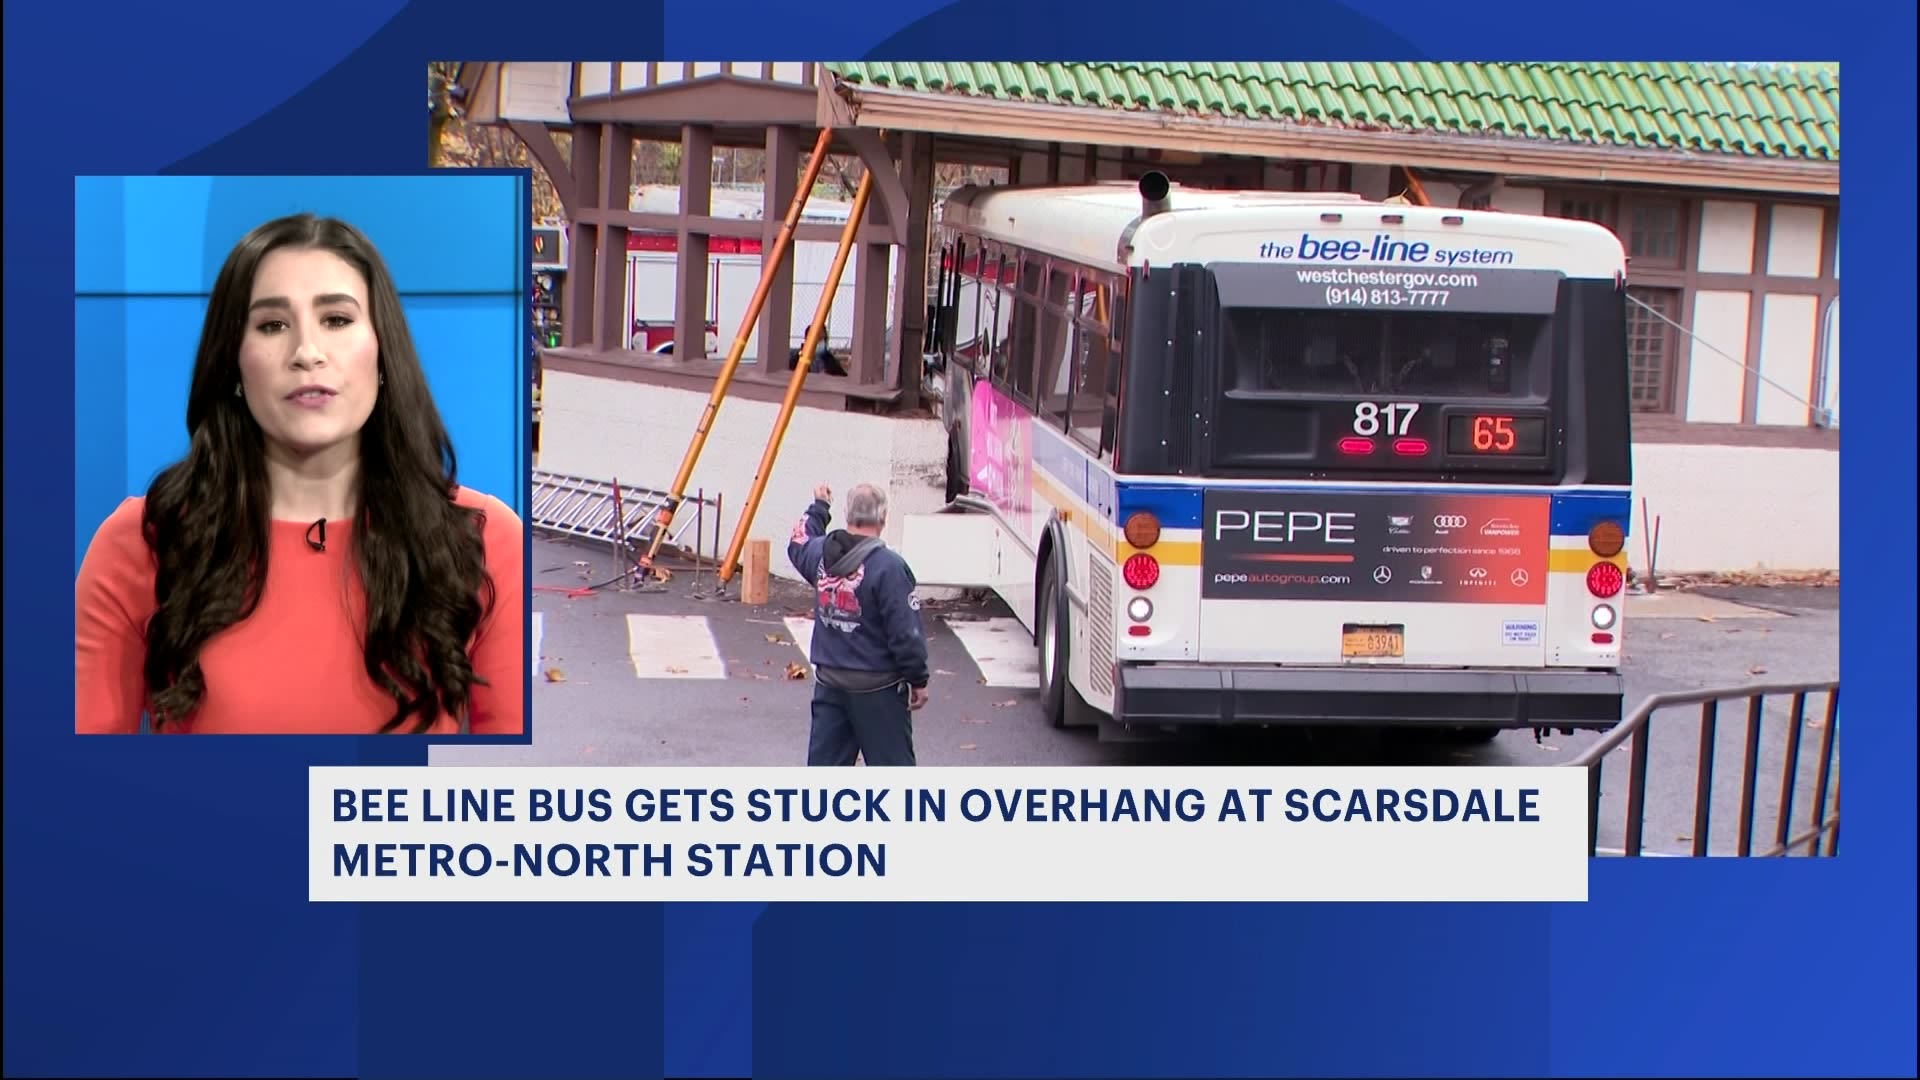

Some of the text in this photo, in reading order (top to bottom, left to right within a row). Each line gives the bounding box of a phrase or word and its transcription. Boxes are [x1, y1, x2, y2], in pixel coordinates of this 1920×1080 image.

[1260, 233, 1514, 267] the bee-line system
[1296, 268, 1478, 289] westchestergov.com
[1325, 286, 1450, 307] (914) 813-7777
[1353, 402, 1420, 436] 817
[1473, 417, 1515, 451] 65
[1215, 510, 1356, 543] PEPE
[1413, 546, 1422, 554] to
[1424, 546, 1471, 556] perfection
[1215, 573, 1351, 585] pepeautogroup.com
